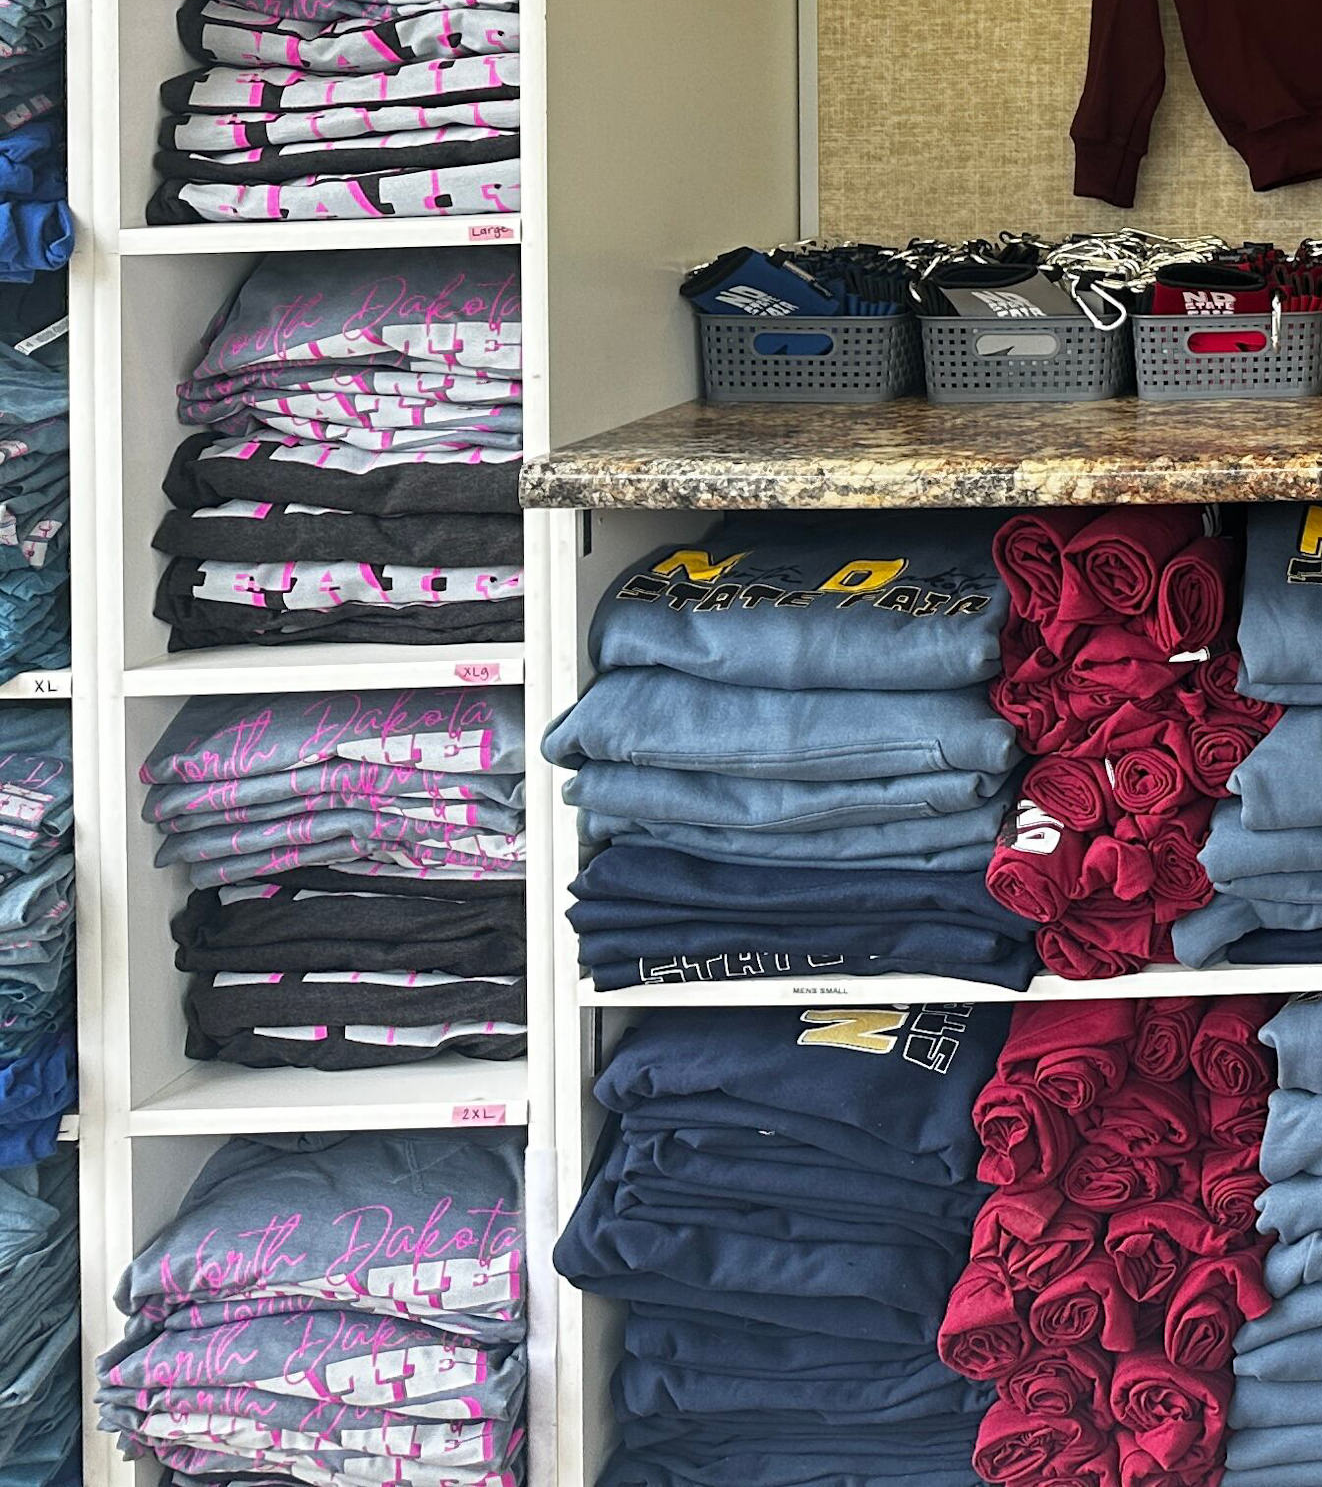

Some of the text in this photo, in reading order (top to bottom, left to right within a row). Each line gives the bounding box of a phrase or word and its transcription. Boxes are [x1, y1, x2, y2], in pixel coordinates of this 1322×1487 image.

[471, 226, 512, 239] Large
[1182, 291, 1237, 304] ND
[1185, 300, 1236, 311] STATE
[615, 574, 993, 618] STATE FAIR
[34, 680, 58, 693] XL
[298, 689, 494, 764] Dakota
[792, 987, 848, 995] MENS SMALL
[158, 1196, 523, 1304] North Dakota
